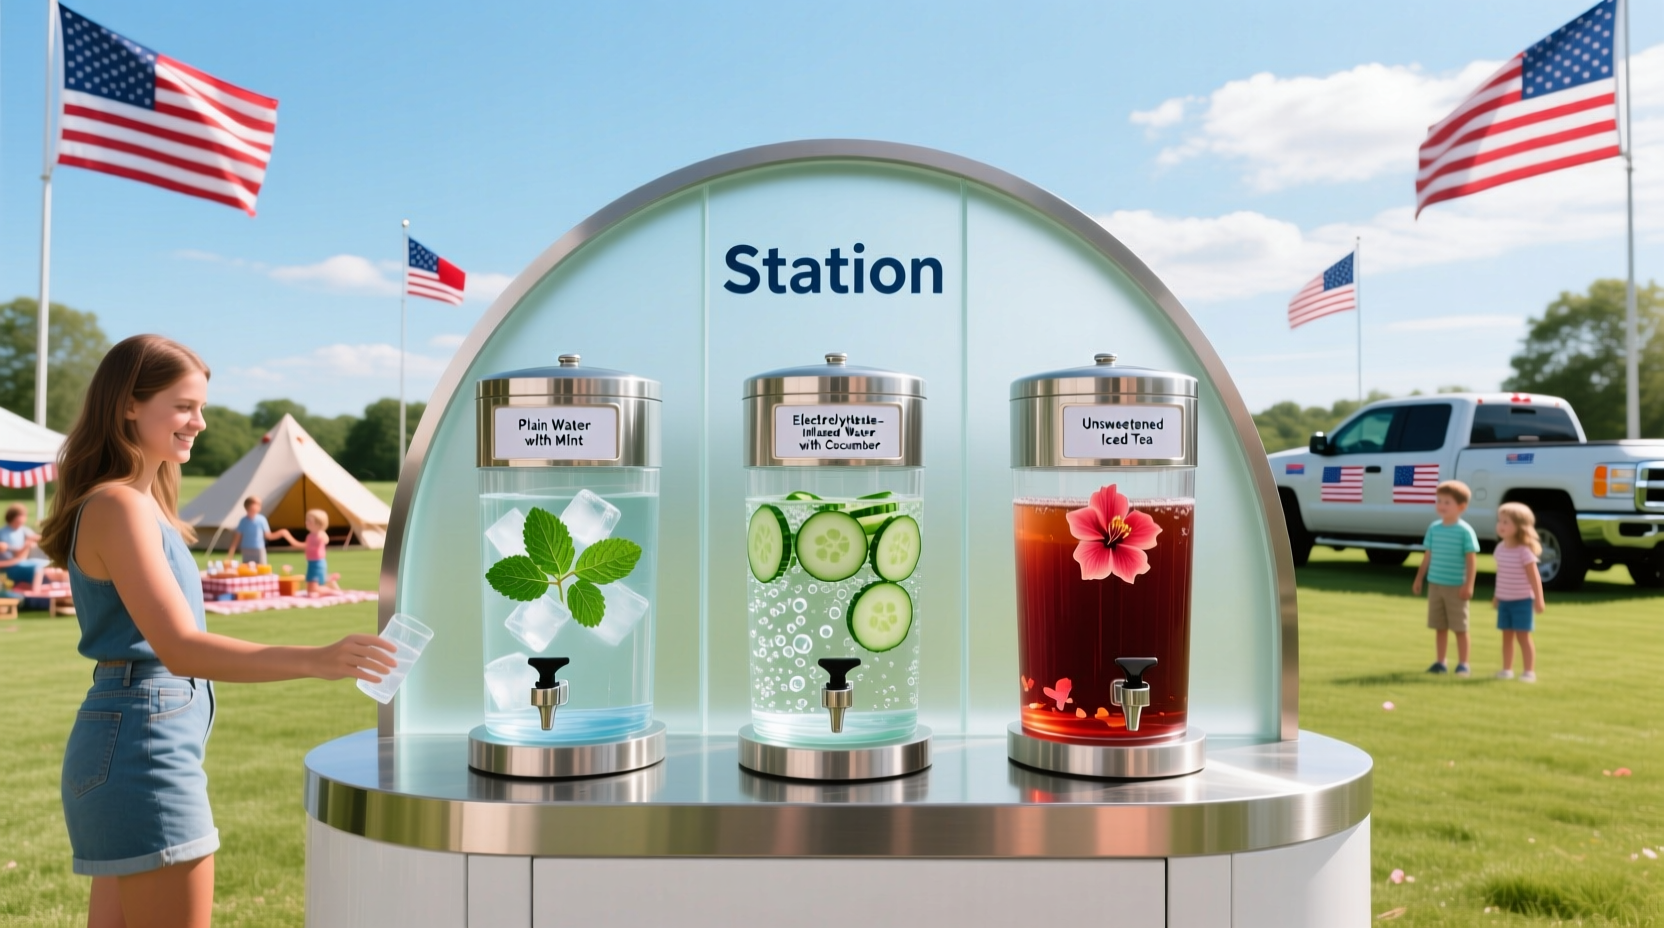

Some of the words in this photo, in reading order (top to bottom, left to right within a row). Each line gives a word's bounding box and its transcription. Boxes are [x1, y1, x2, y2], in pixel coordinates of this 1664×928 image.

[723, 242, 944, 295] Station
[518, 417, 548, 431] Plain
[551, 418, 592, 432] Water
[798, 438, 822, 451] with
[1101, 432, 1129, 446] Iced
[1131, 432, 1154, 446] Tea
